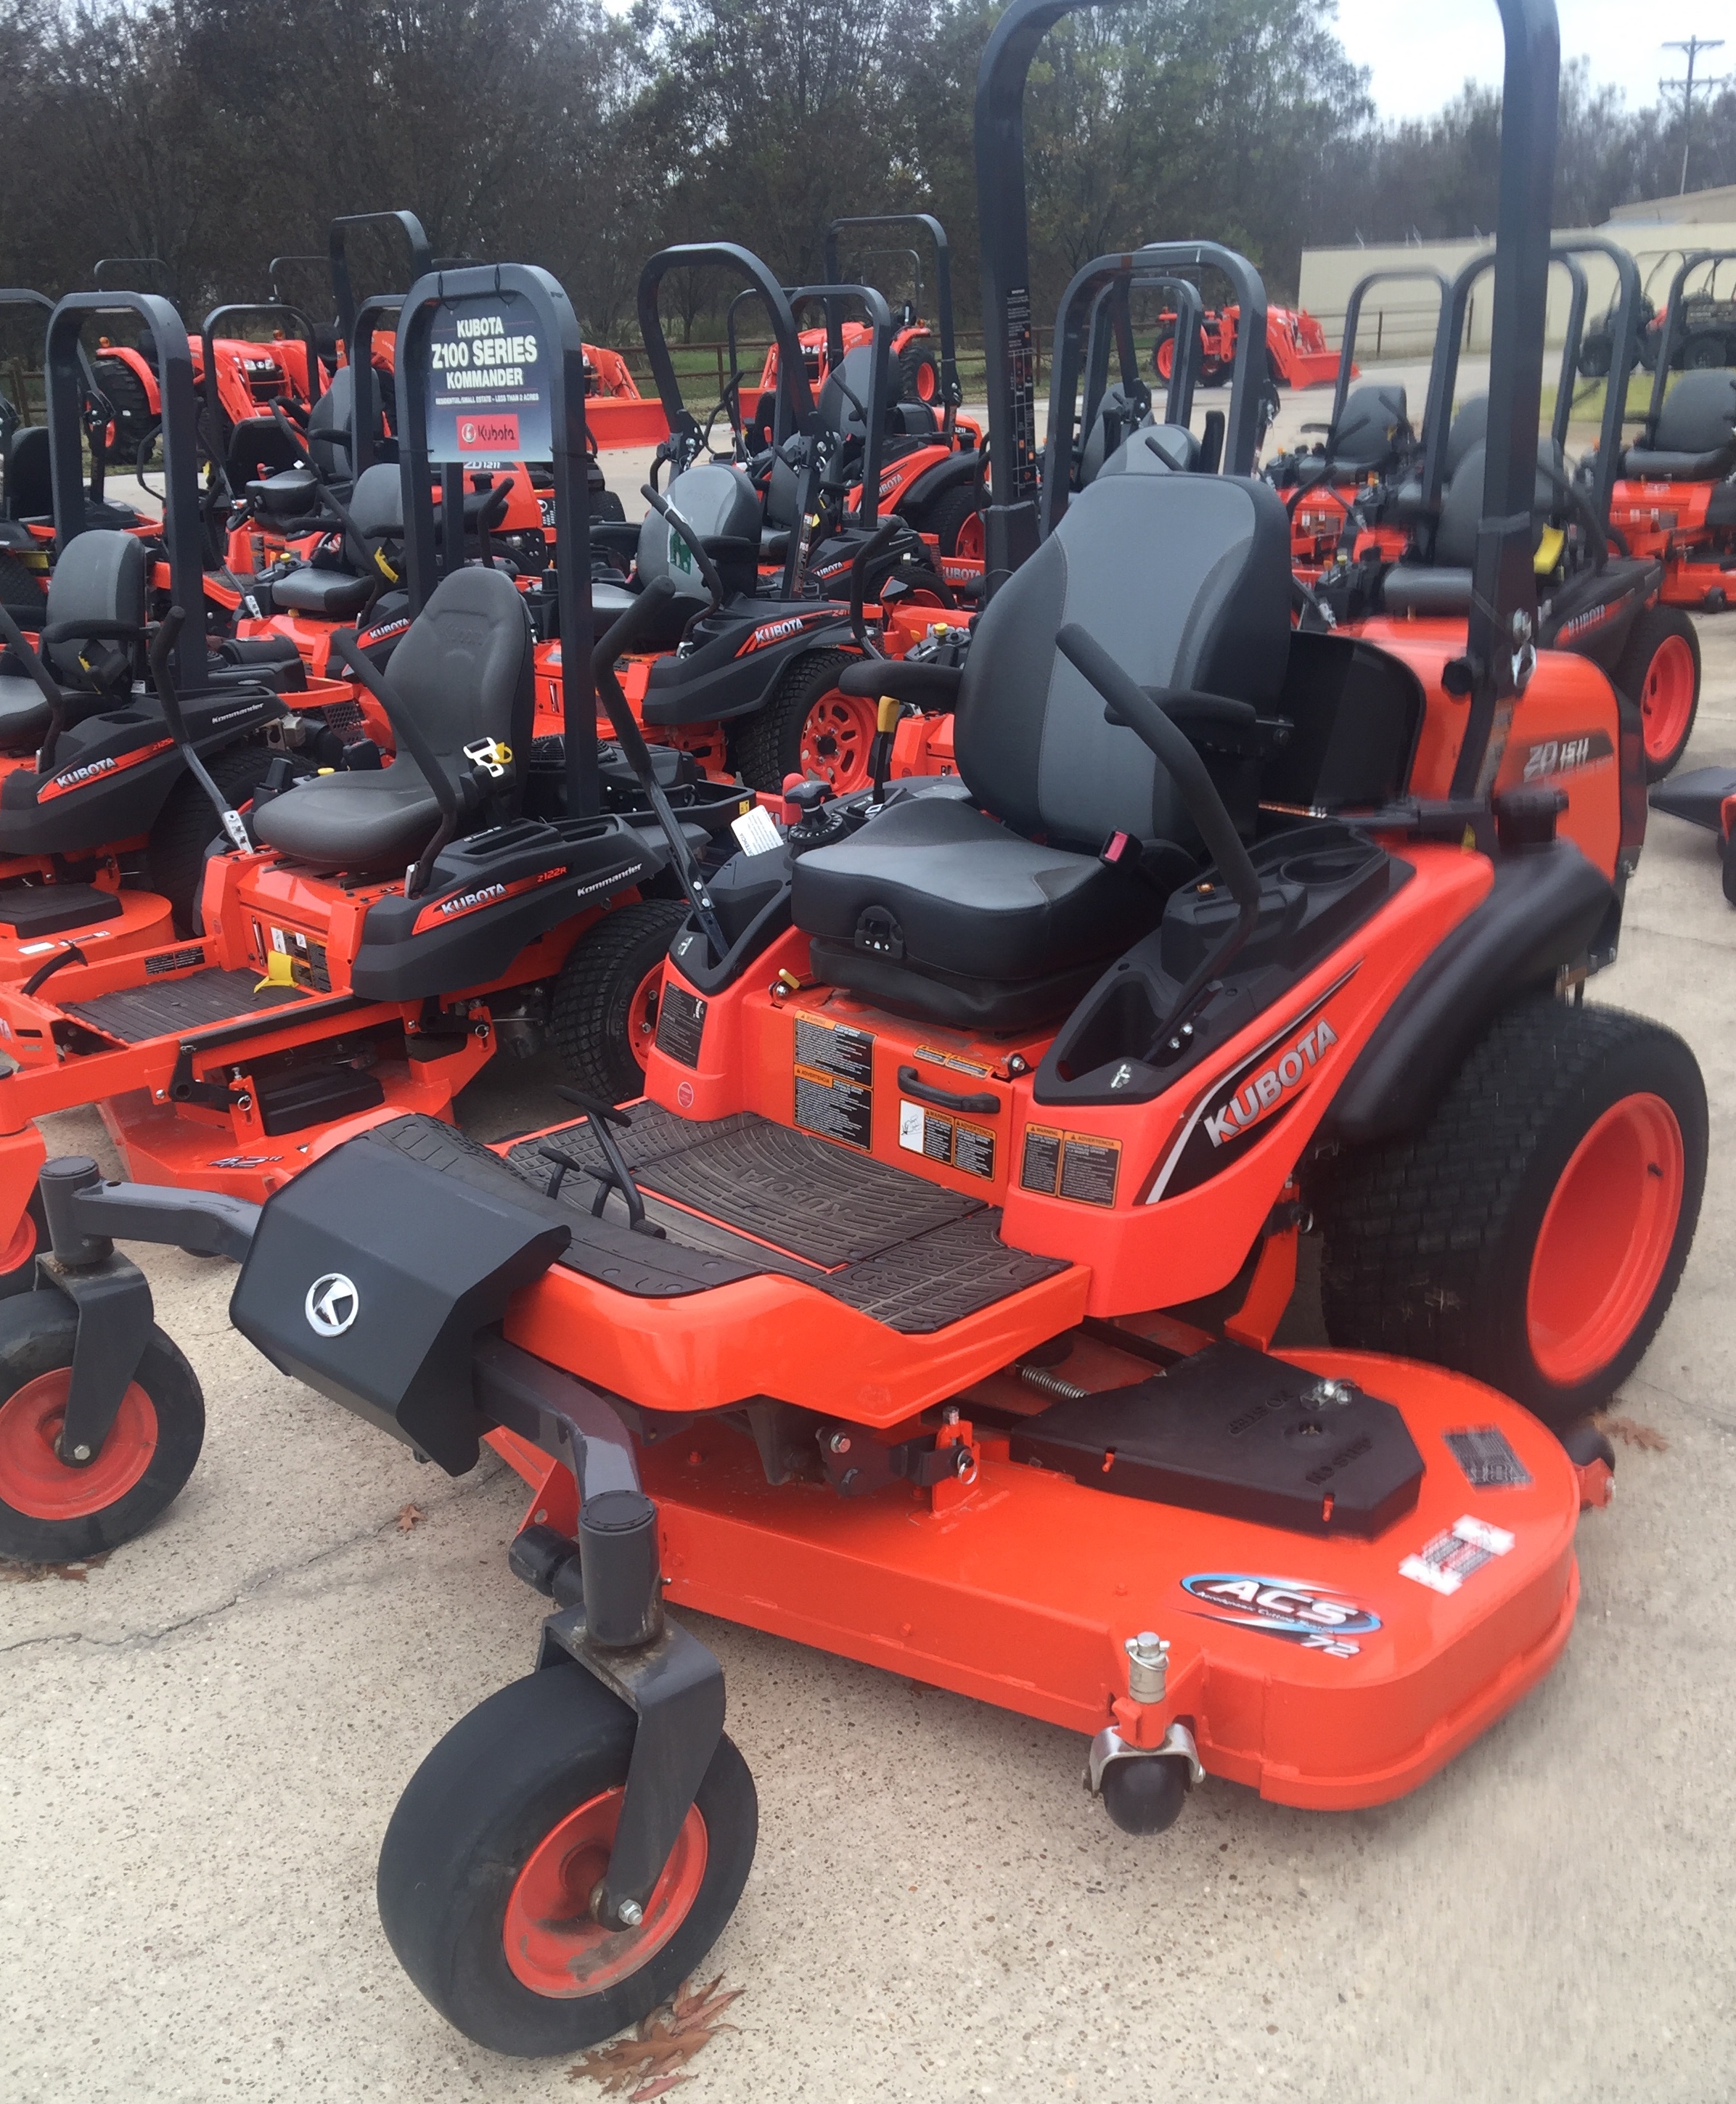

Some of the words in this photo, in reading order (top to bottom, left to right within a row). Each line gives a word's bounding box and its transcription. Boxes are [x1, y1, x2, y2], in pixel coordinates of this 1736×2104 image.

[456, 316, 504, 338] KUBOTA
[431, 341, 469, 369] Z100
[472, 335, 538, 366] SERIES
[446, 367, 524, 389] KOMMANDER
[478, 425, 516, 441] Kubota
[879, 474, 903, 494] BOTA
[943, 566, 981, 581] UBOTA
[369, 618, 410, 639] KUBOTA
[754, 618, 804, 644] KUBOTA
[56, 757, 117, 788] KUBOTA
[577, 863, 642, 898] Kommander
[441, 883, 507, 917] KUBOTA
[1203, 1020, 1339, 1148] KUBOTA
[1206, 1579, 1359, 1625] ACS
[1300, 1634, 1361, 1660] 72
